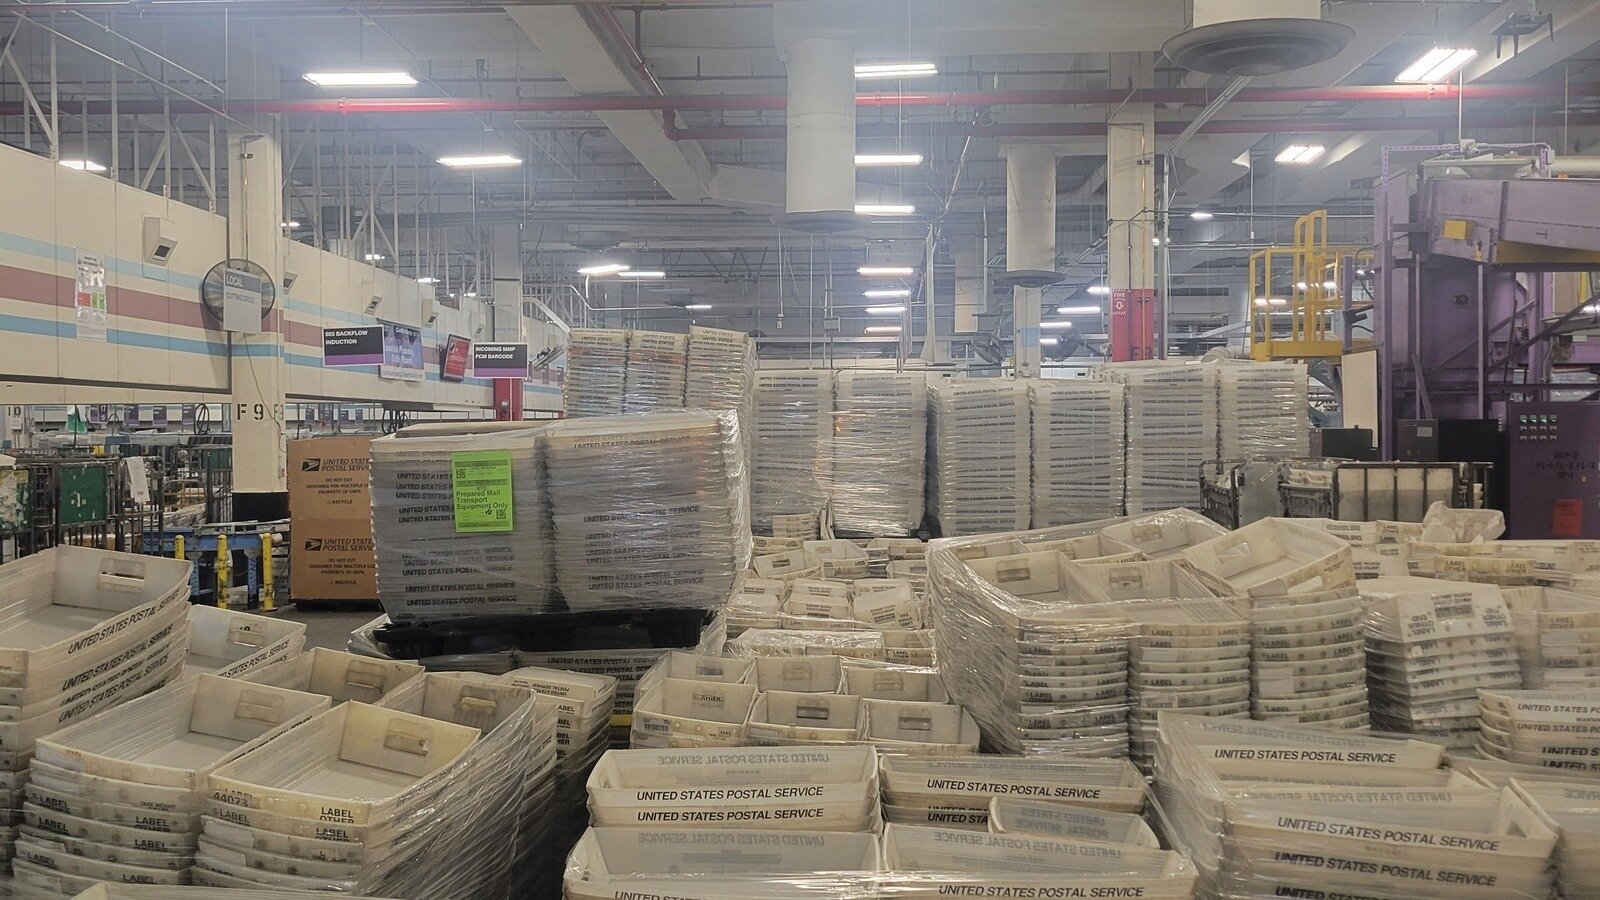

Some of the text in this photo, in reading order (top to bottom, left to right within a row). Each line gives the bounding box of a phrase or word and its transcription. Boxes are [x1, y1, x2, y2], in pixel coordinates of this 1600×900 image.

[226, 275, 244, 288] LOCAL
[237, 404, 264, 420] F 9
[493, 502, 508, 510] Only
[669, 505, 699, 514] SERVICE
[674, 577, 704, 585] SERVICE
[68, 589, 180, 654] UNITED STATES POSTAL SERVICE
[62, 624, 174, 691] UNITED STATES POSTAL SERVICE
[226, 639, 290, 678] STATES POSTAL SERVICE
[1518, 704, 1551, 712] UNITED
[1553, 706, 1588, 714] STATES
[1215, 749, 1396, 763] UNITED STATES POSTAL SERVICE
[1542, 747, 1589, 756] UNITED
[637, 787, 824, 801] UNITED STATES POSTAL SERVICE
[927, 779, 1101, 799] UNITED STATES POSTAL SERVICE
[40, 795, 68, 808] LABEL
[213, 792, 250, 807] 44073
[220, 809, 250, 823] LABEL
[321, 806, 354, 818] LABEL
[638, 808, 824, 821] UNITED STATES POSTAL SERVICE
[928, 813, 988, 824] UNITED STA
[136, 816, 169, 827] LABEL
[316, 827, 349, 839] LABEL
[1278, 817, 1499, 851] UNITED STATES POSTAL SERVICE
[135, 839, 167, 850] LABEL
[1276, 852, 1498, 887] UNITED STATES POSTAL SERVICE
[939, 884, 1144, 898] UNITED STATES POSTAL SERVICE
